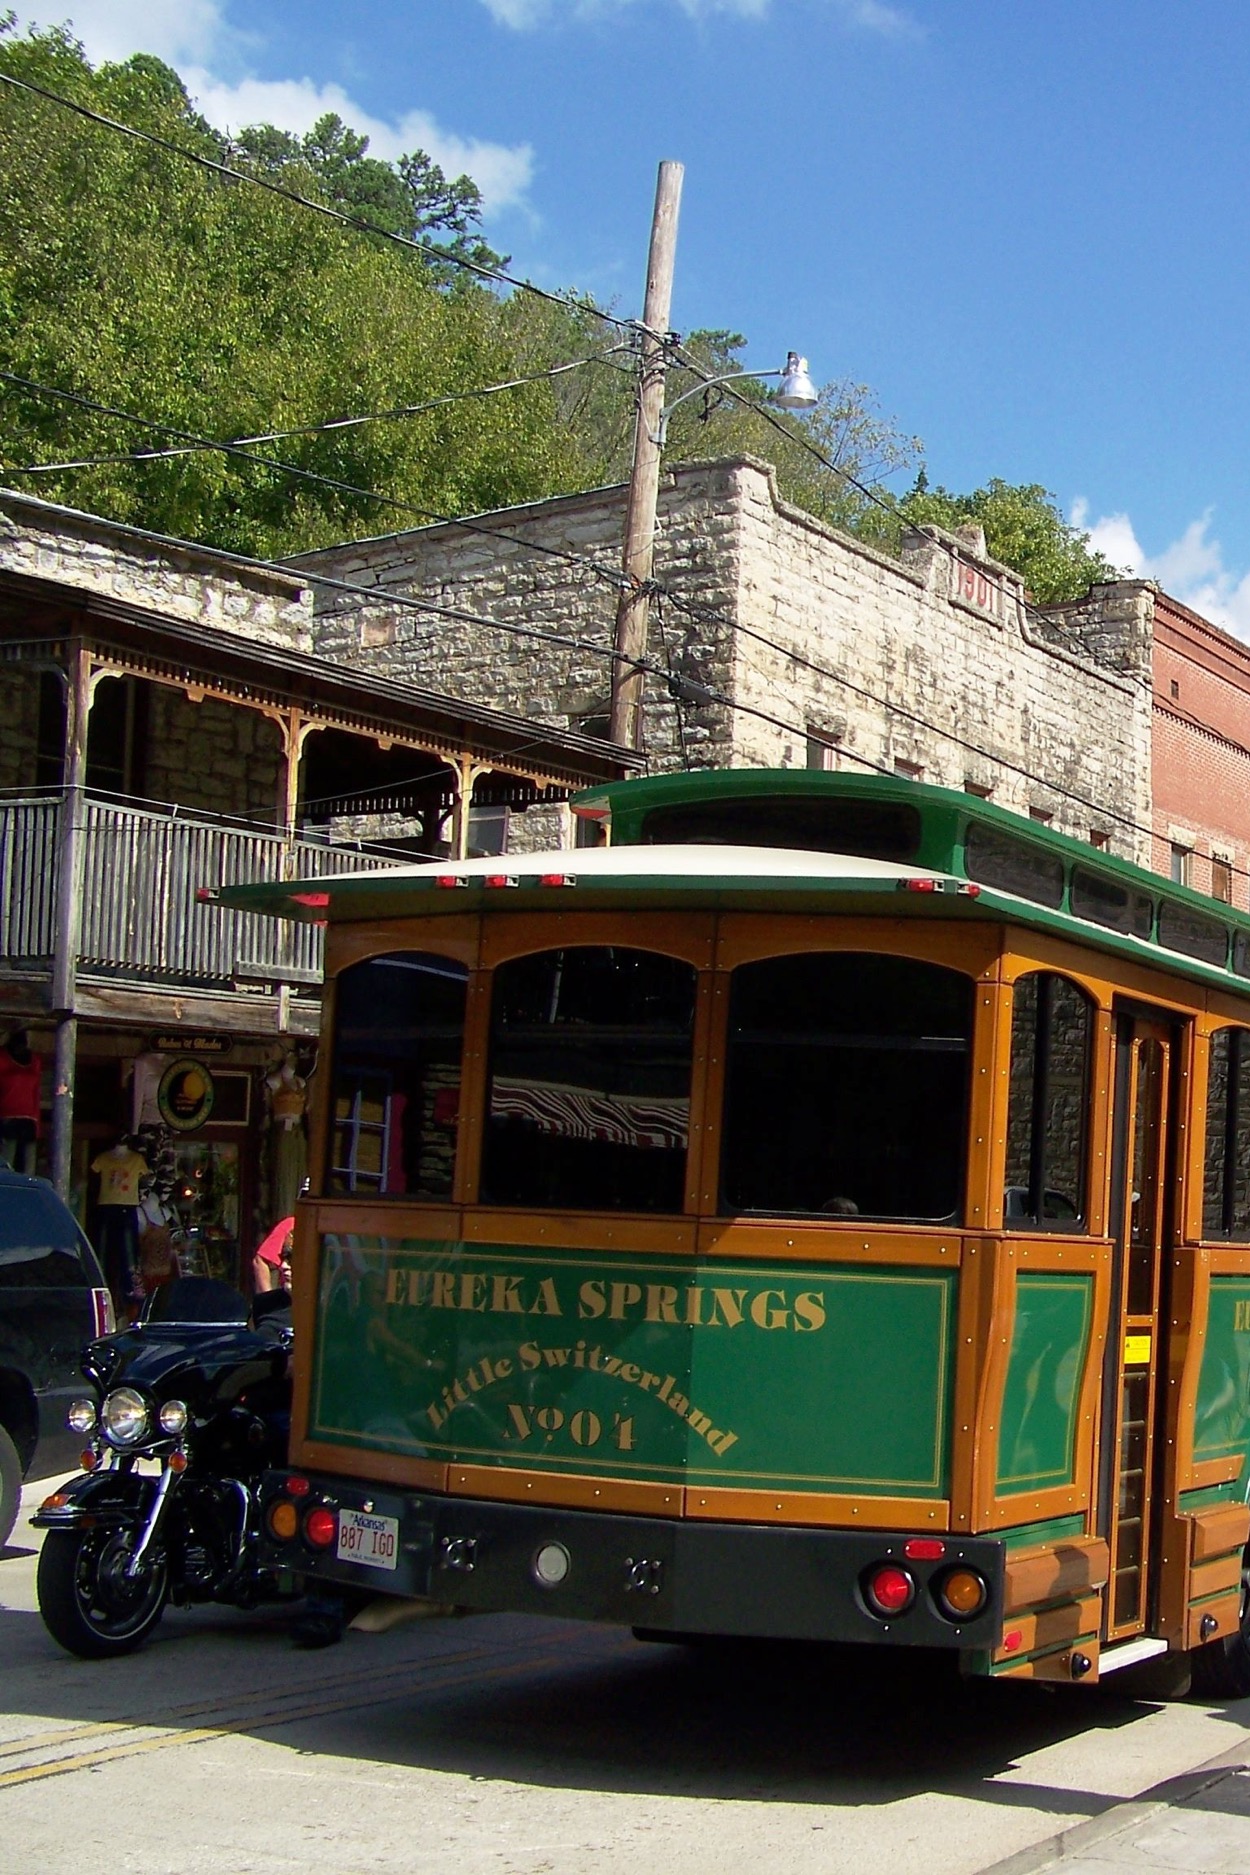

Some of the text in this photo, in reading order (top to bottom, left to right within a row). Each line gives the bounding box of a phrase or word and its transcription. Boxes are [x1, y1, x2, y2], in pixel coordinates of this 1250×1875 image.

[385, 1268, 827, 1333] EUREKA SPRINGS
[425, 1340, 740, 1458] Little Switzerland
[340, 1525, 364, 1551] 887
[352, 1513, 386, 1532] Arkansas
